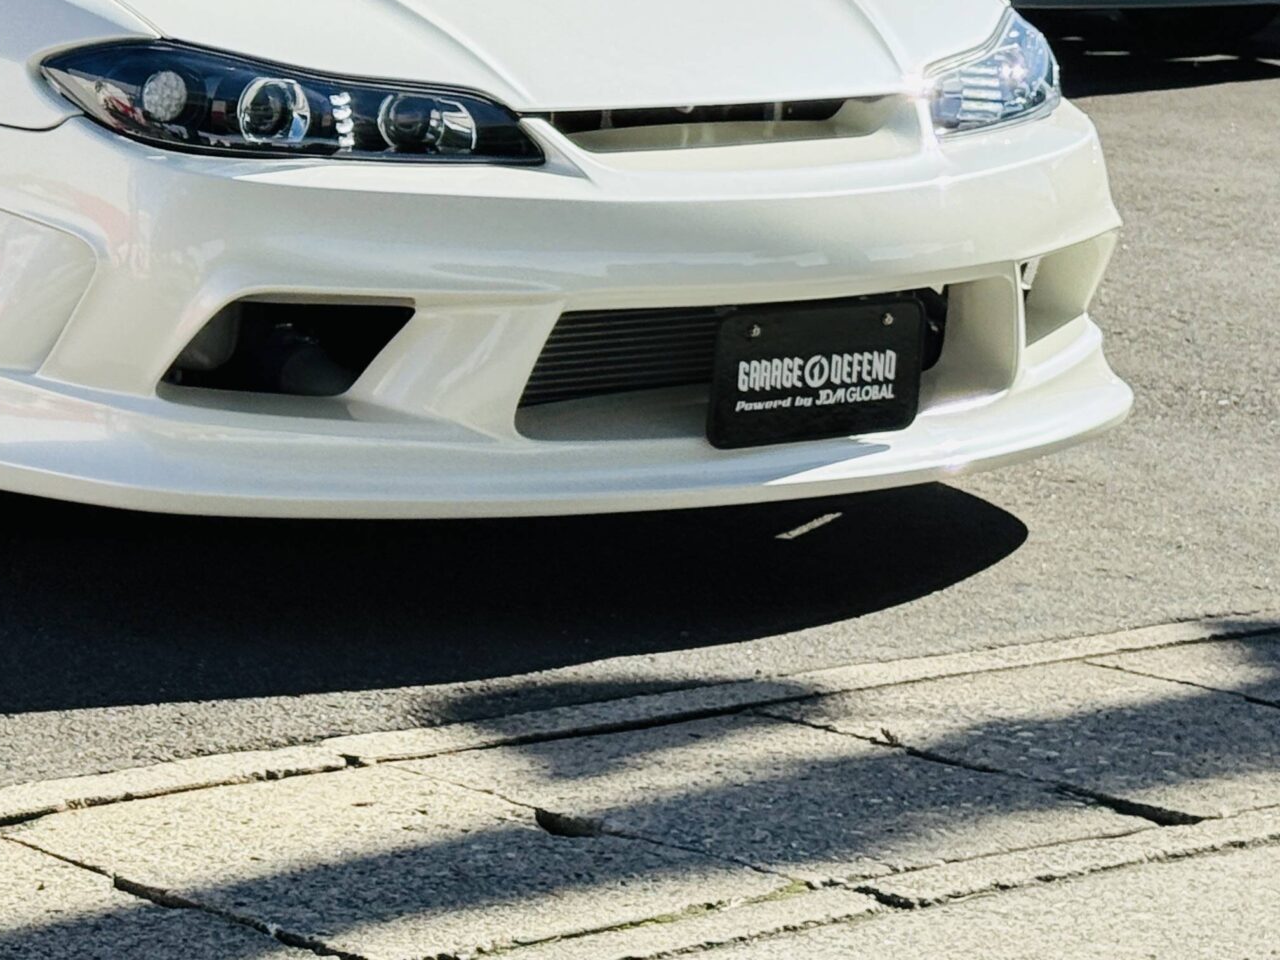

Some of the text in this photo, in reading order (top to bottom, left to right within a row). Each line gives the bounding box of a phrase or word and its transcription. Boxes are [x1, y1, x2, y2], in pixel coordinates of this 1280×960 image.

[738, 350, 896, 391] GARAGE DEFEND
[794, 396, 813, 407] by
[846, 384, 894, 403] GLOBAL
